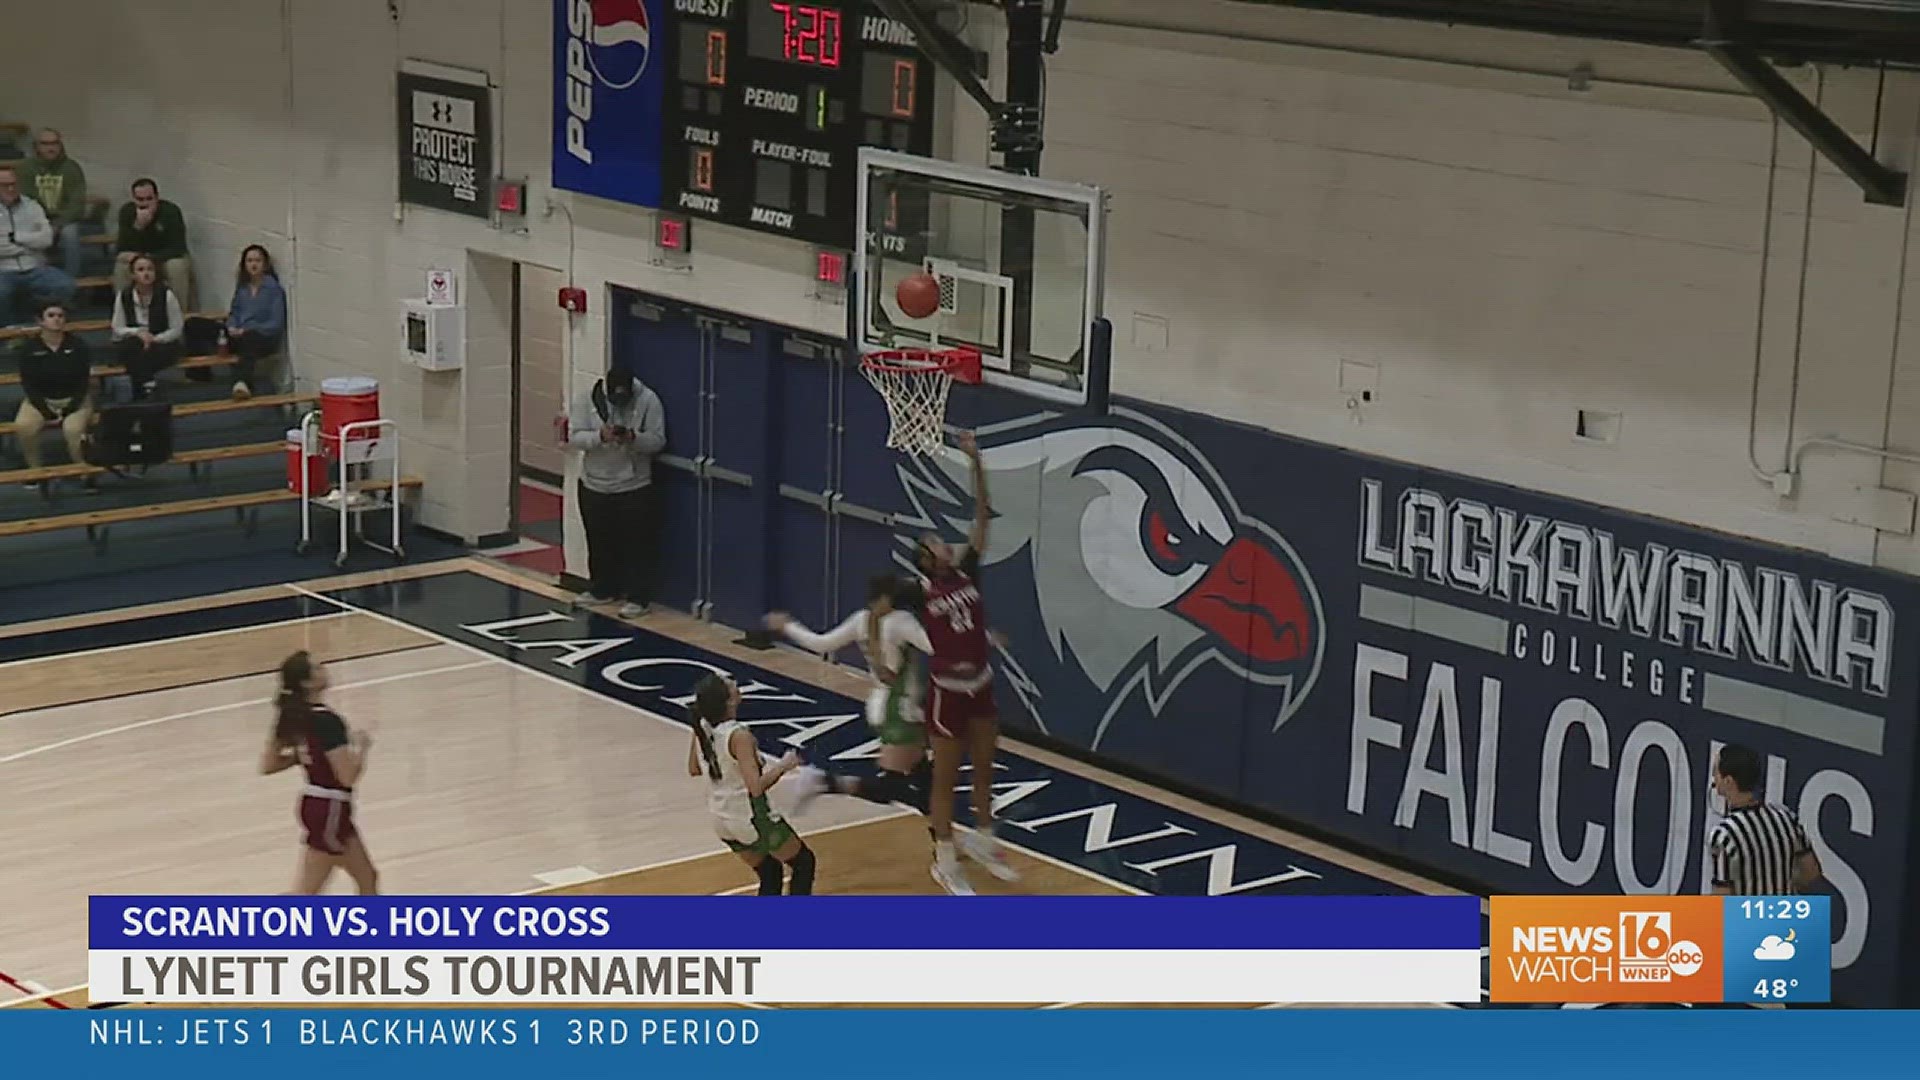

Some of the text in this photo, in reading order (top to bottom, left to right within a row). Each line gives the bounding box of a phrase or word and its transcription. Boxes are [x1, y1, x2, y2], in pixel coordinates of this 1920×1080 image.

[770, 1, 842, 68] 7:20
[861, 16, 919, 46] HOME
[707, 31, 727, 85] 0
[744, 87, 798, 113] PERIOD
[893, 59, 915, 117] 0
[412, 127, 476, 165] PROTECT
[684, 126, 720, 146] FOULS
[413, 156, 477, 190] THIS HOUSE
[679, 192, 719, 213] POINTS
[750, 207, 793, 229] MATCH
[865, 230, 906, 252] PONTS
[1358, 477, 1893, 697] LACKAWANNA
[1514, 622, 1695, 704] COLLEGE
[1347, 642, 1876, 969] FALCOS
